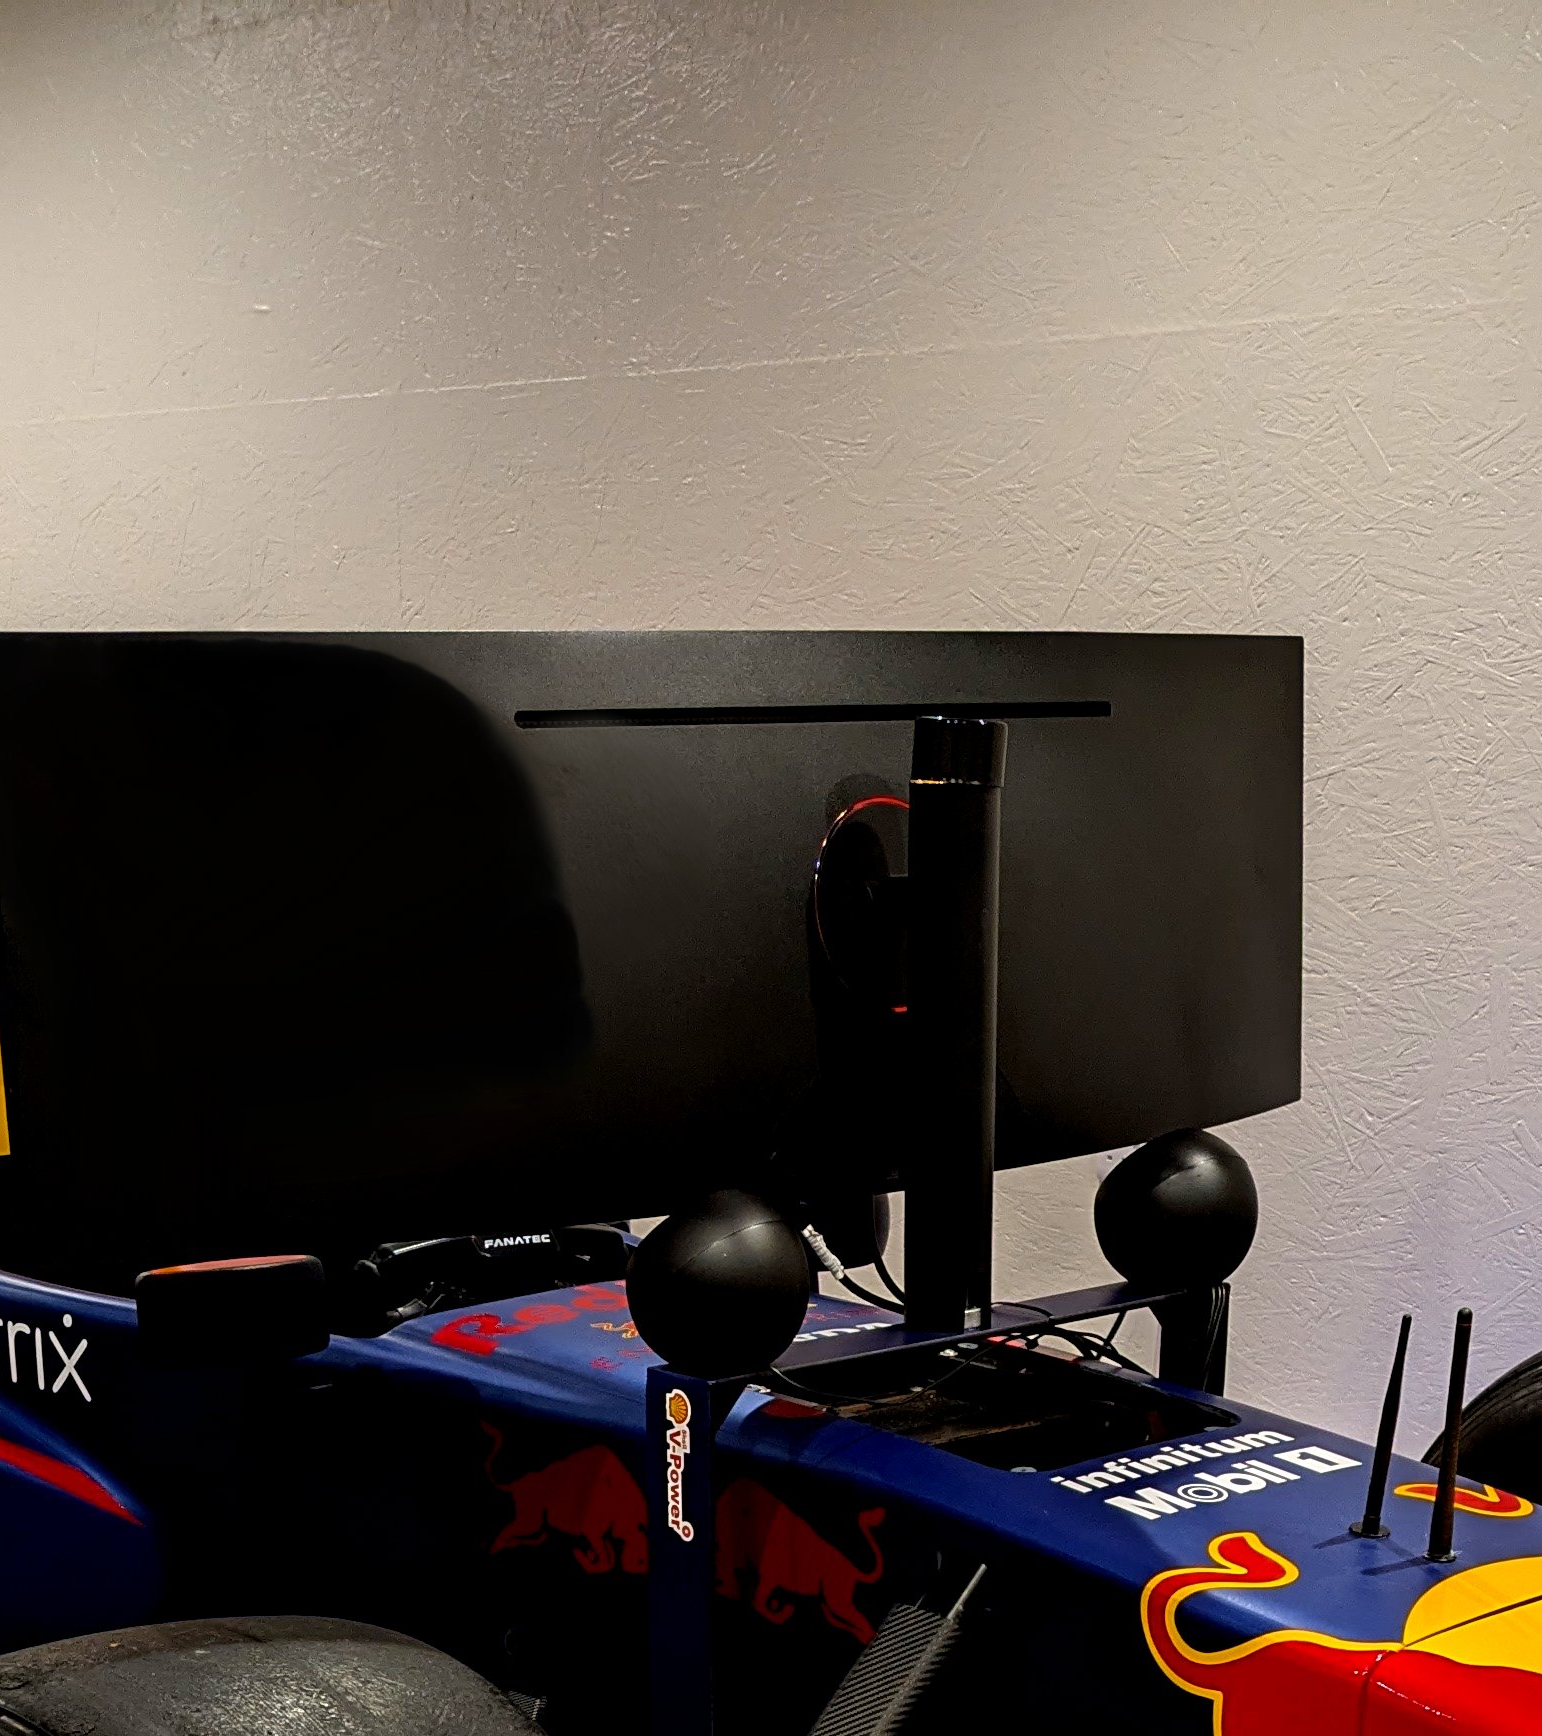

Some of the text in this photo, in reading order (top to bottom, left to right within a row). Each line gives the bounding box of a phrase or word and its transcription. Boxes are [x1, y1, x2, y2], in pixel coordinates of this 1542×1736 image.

[484, 1234, 551, 1249] FANATEC
[1050, 1430, 1295, 1493] infinitum
[1104, 1459, 1301, 1520] Mobil
